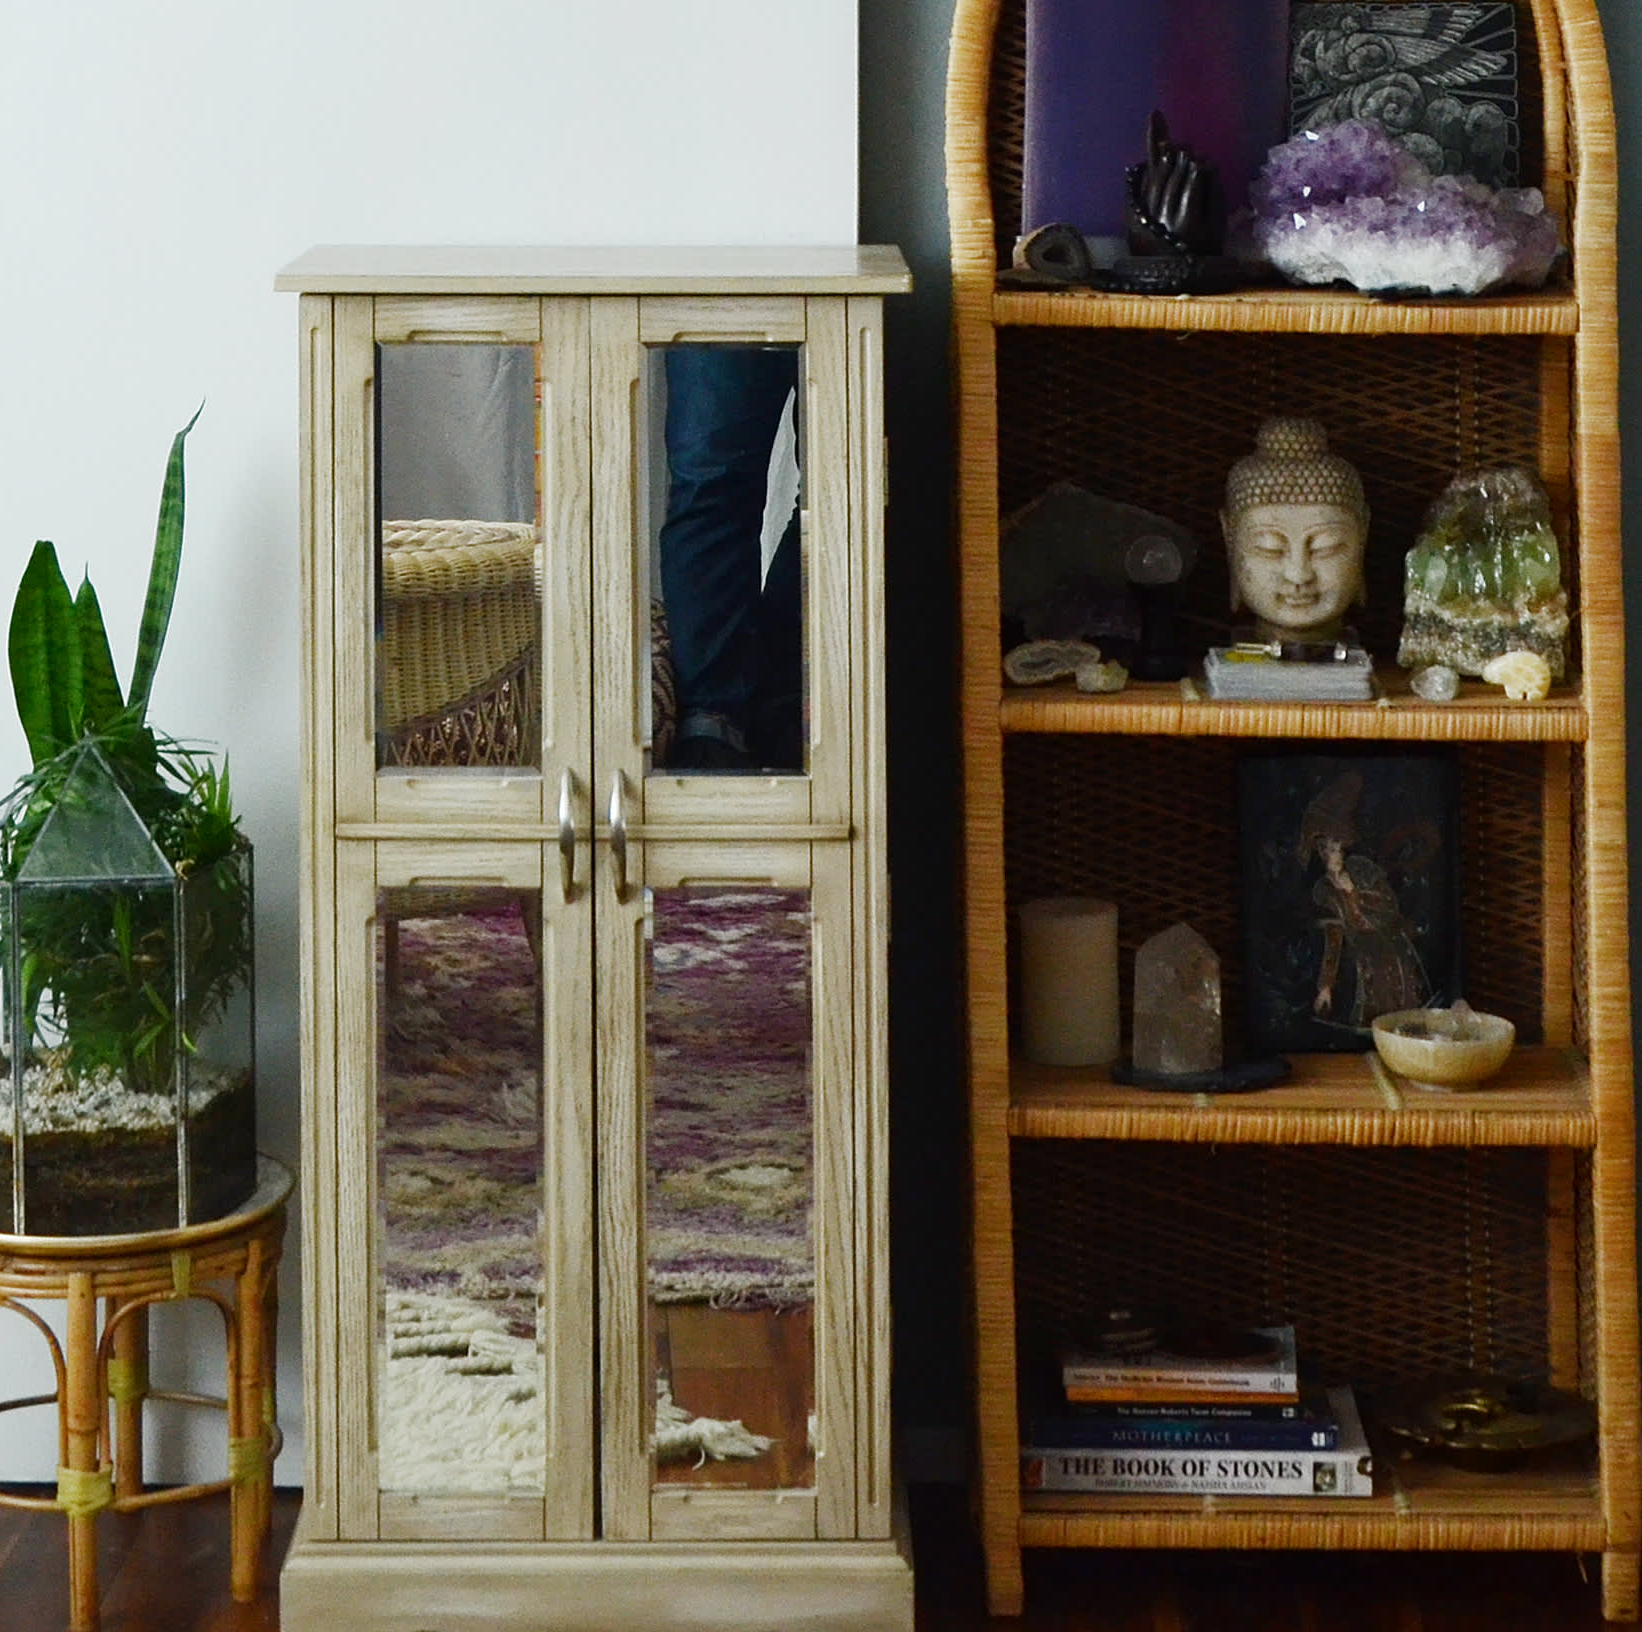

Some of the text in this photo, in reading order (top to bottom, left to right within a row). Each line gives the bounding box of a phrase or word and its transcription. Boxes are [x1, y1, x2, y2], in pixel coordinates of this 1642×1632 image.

[1059, 1457, 1304, 1479] THE BOOK OF STONES
